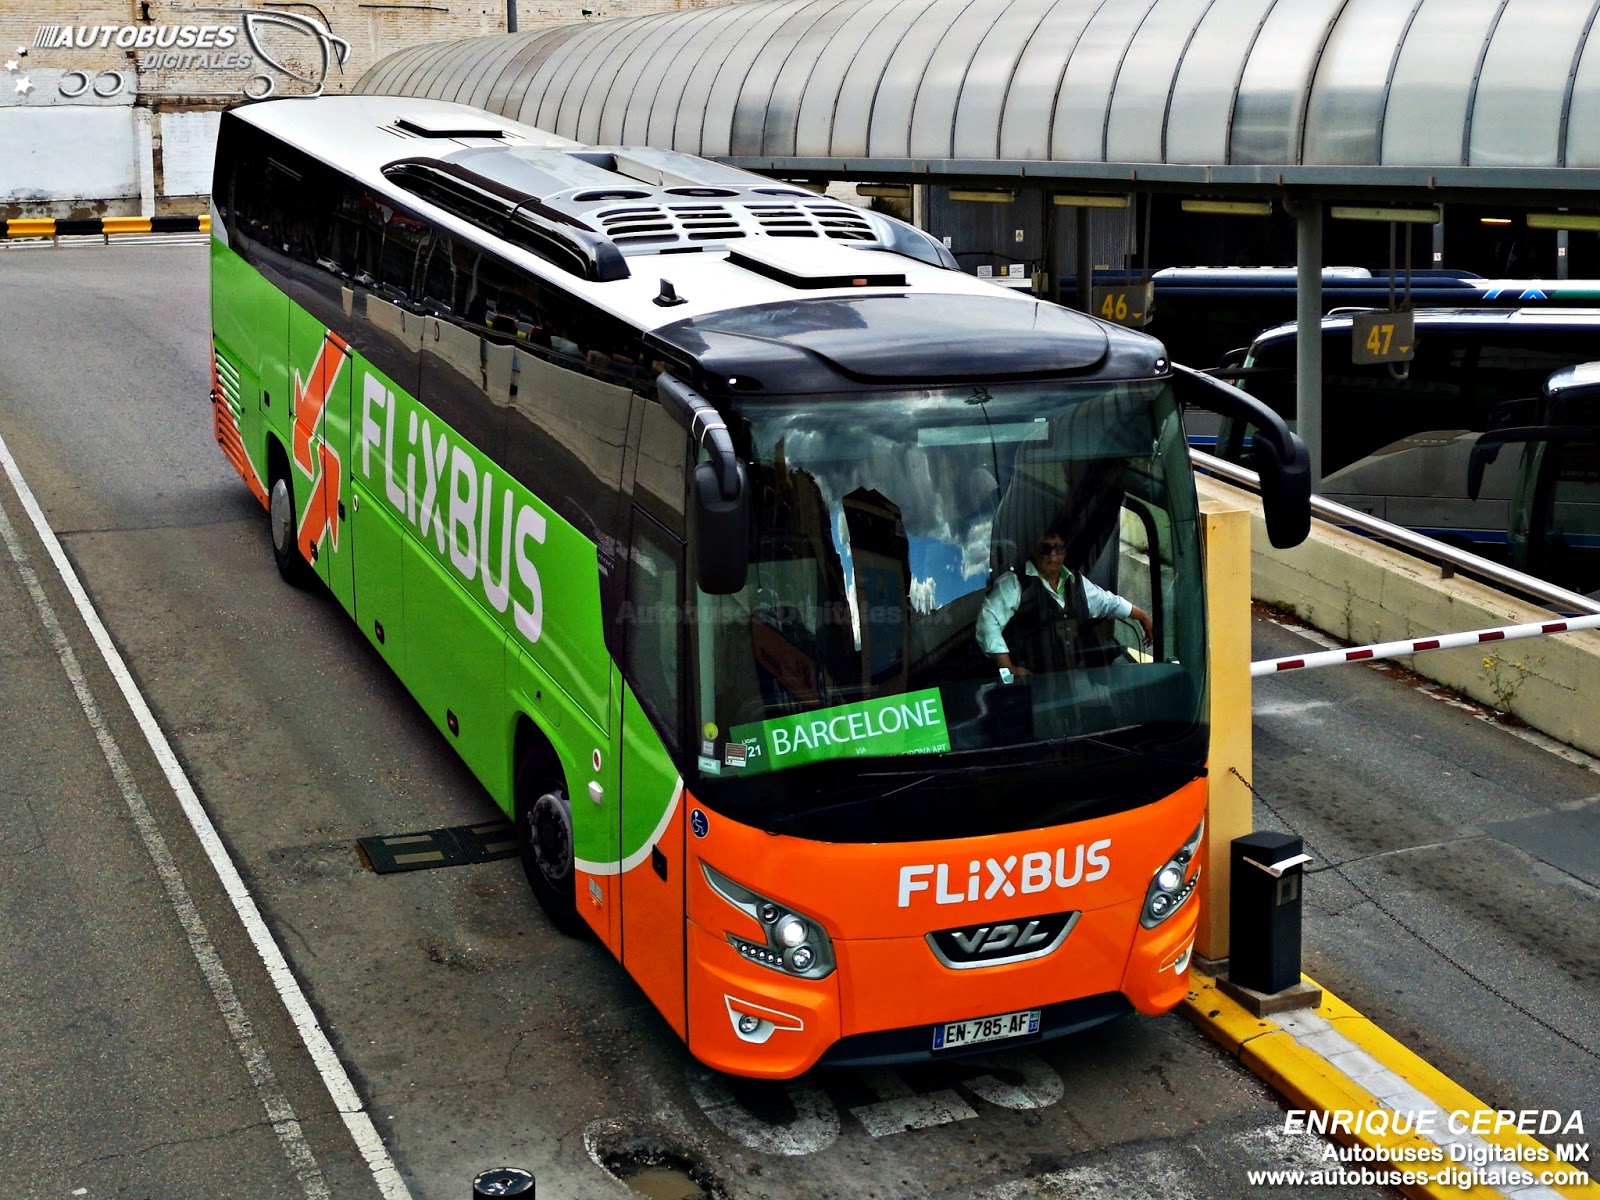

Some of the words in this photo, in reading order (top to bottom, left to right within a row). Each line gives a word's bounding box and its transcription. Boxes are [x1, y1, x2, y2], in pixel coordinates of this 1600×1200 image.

[1102, 294, 1128, 320] 46
[1366, 324, 1395, 355] 47
[741, 737, 758, 745] LIGNE
[772, 699, 941, 756] BARCELONE
[747, 745, 762, 758] 21
[855, 746, 868, 755] VIA
[951, 920, 1050, 954] VDL
[945, 1013, 1029, 1044] EN-785-AF
